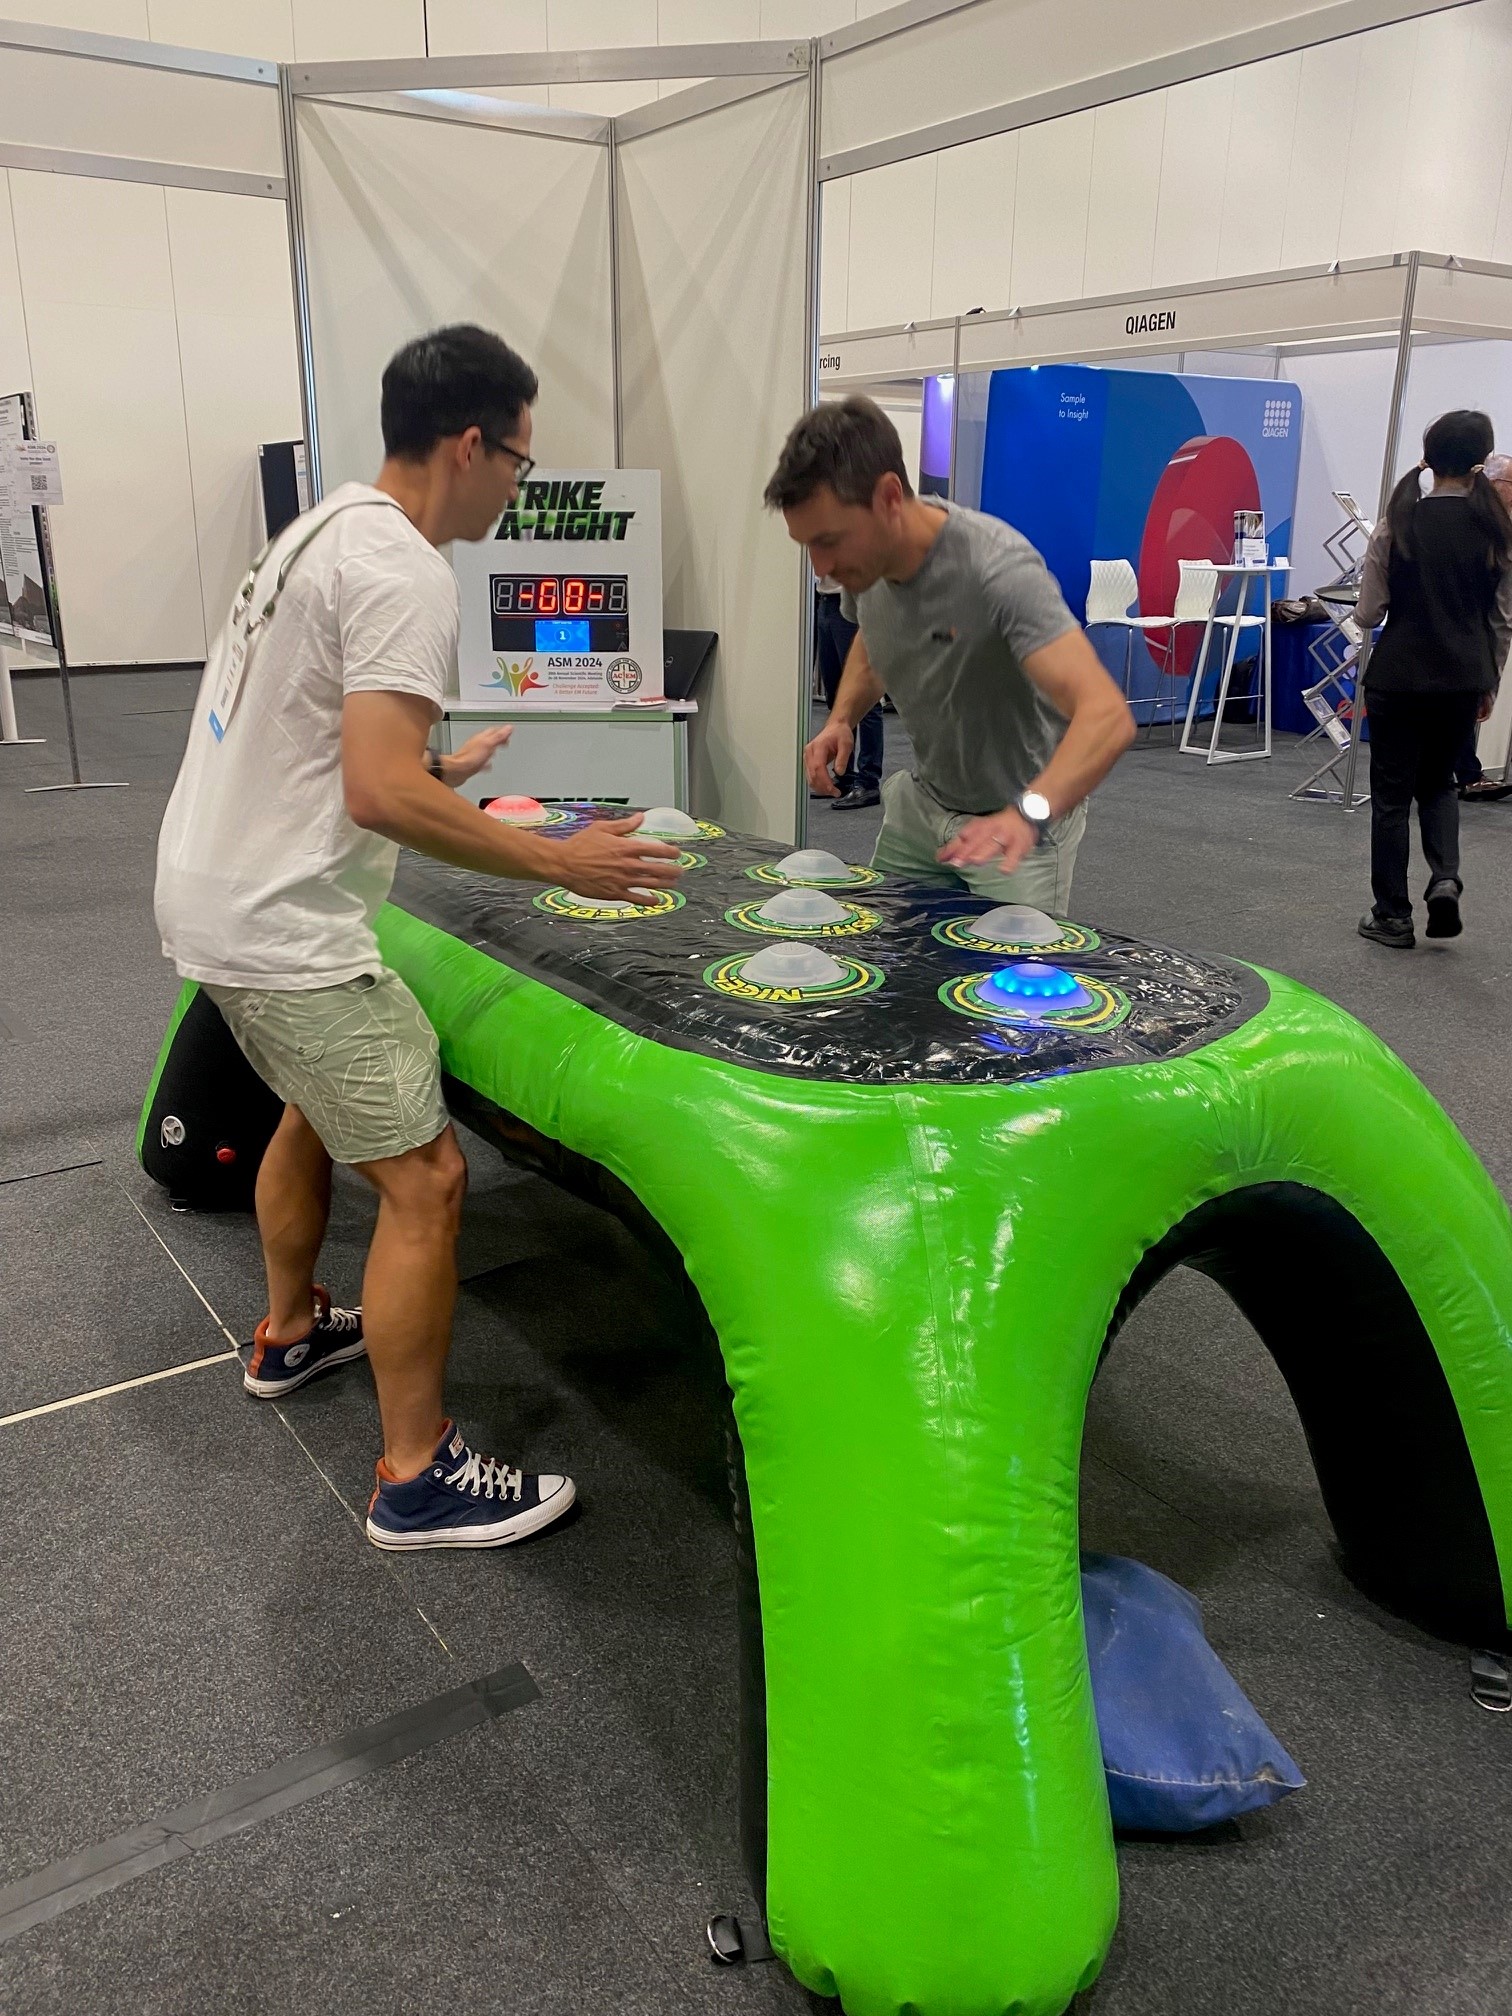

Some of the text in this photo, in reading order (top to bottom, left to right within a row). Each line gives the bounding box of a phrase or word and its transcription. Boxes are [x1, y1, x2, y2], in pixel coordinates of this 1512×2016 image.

[1125, 311, 1176, 335] QIAGEN
[819, 354, 841, 370] rcing
[1060, 392, 1086, 405] Sample
[1058, 408, 1089, 421] to Insight
[1262, 427, 1289, 437] QIAGEN
[506, 481, 606, 510] TRIKE
[494, 511, 636, 540] A-LIGHT
[559, 630, 567, 640] 1
[547, 657, 572, 667] ASM
[575, 657, 603, 667] 2024
[712, 976, 804, 1001] NICE!
